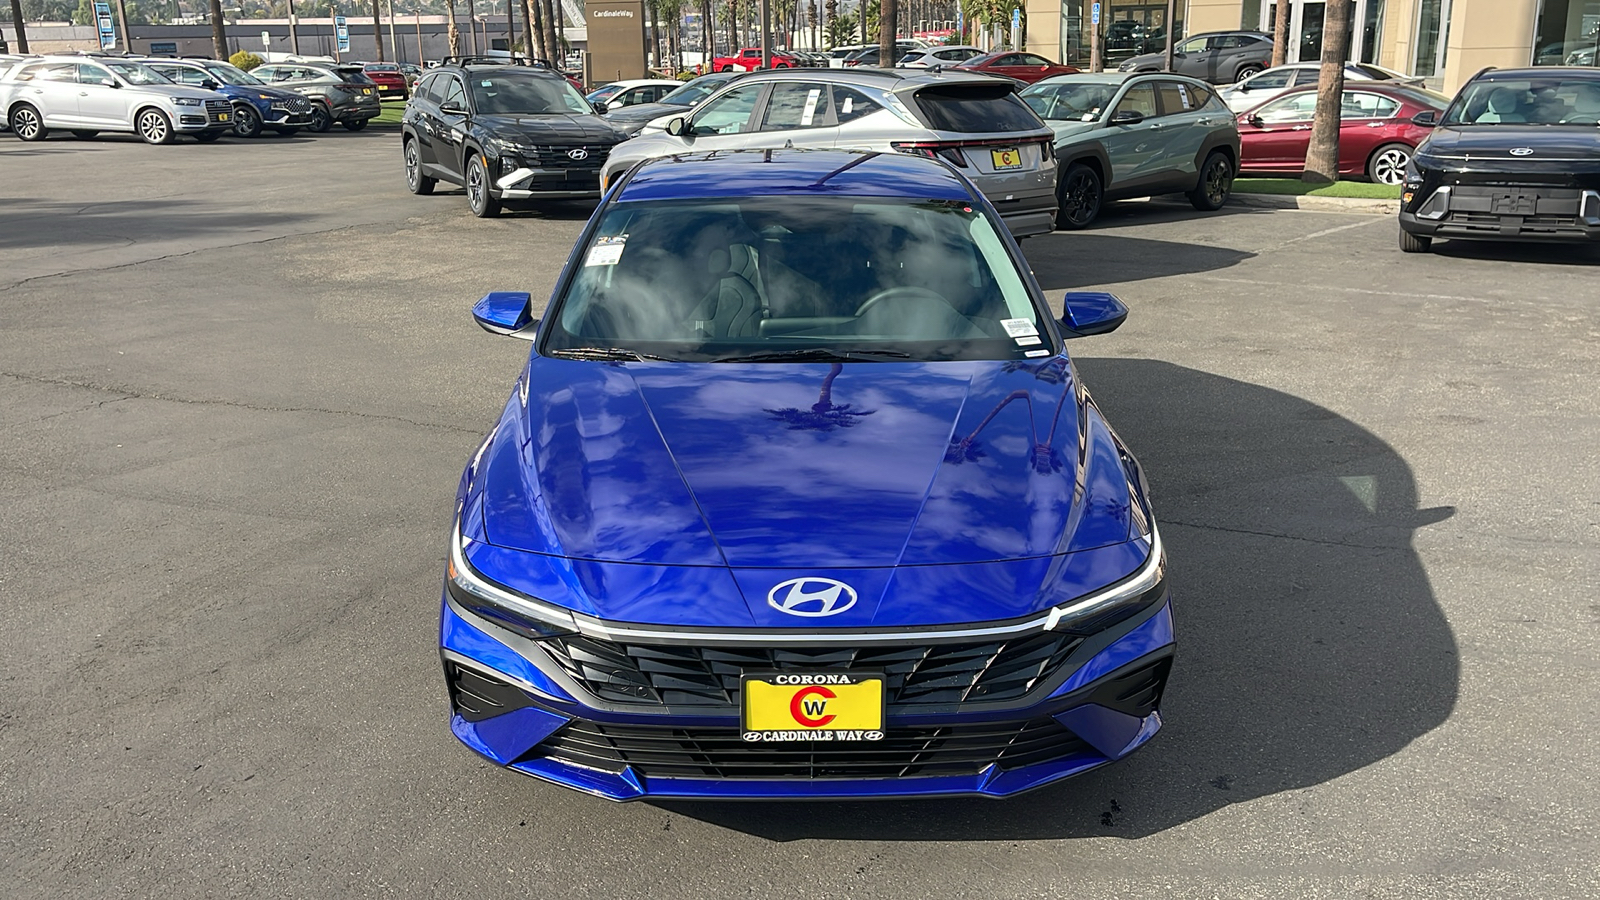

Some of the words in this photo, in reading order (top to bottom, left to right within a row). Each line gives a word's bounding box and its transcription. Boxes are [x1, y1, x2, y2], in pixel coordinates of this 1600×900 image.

[593, 10, 633, 18] CardinaleWay
[776, 674, 851, 685] CORONA
[790, 685, 838, 728] C
[803, 701, 827, 716] W
[762, 730, 834, 742] CARDINALE
[836, 730, 864, 741] WAY
